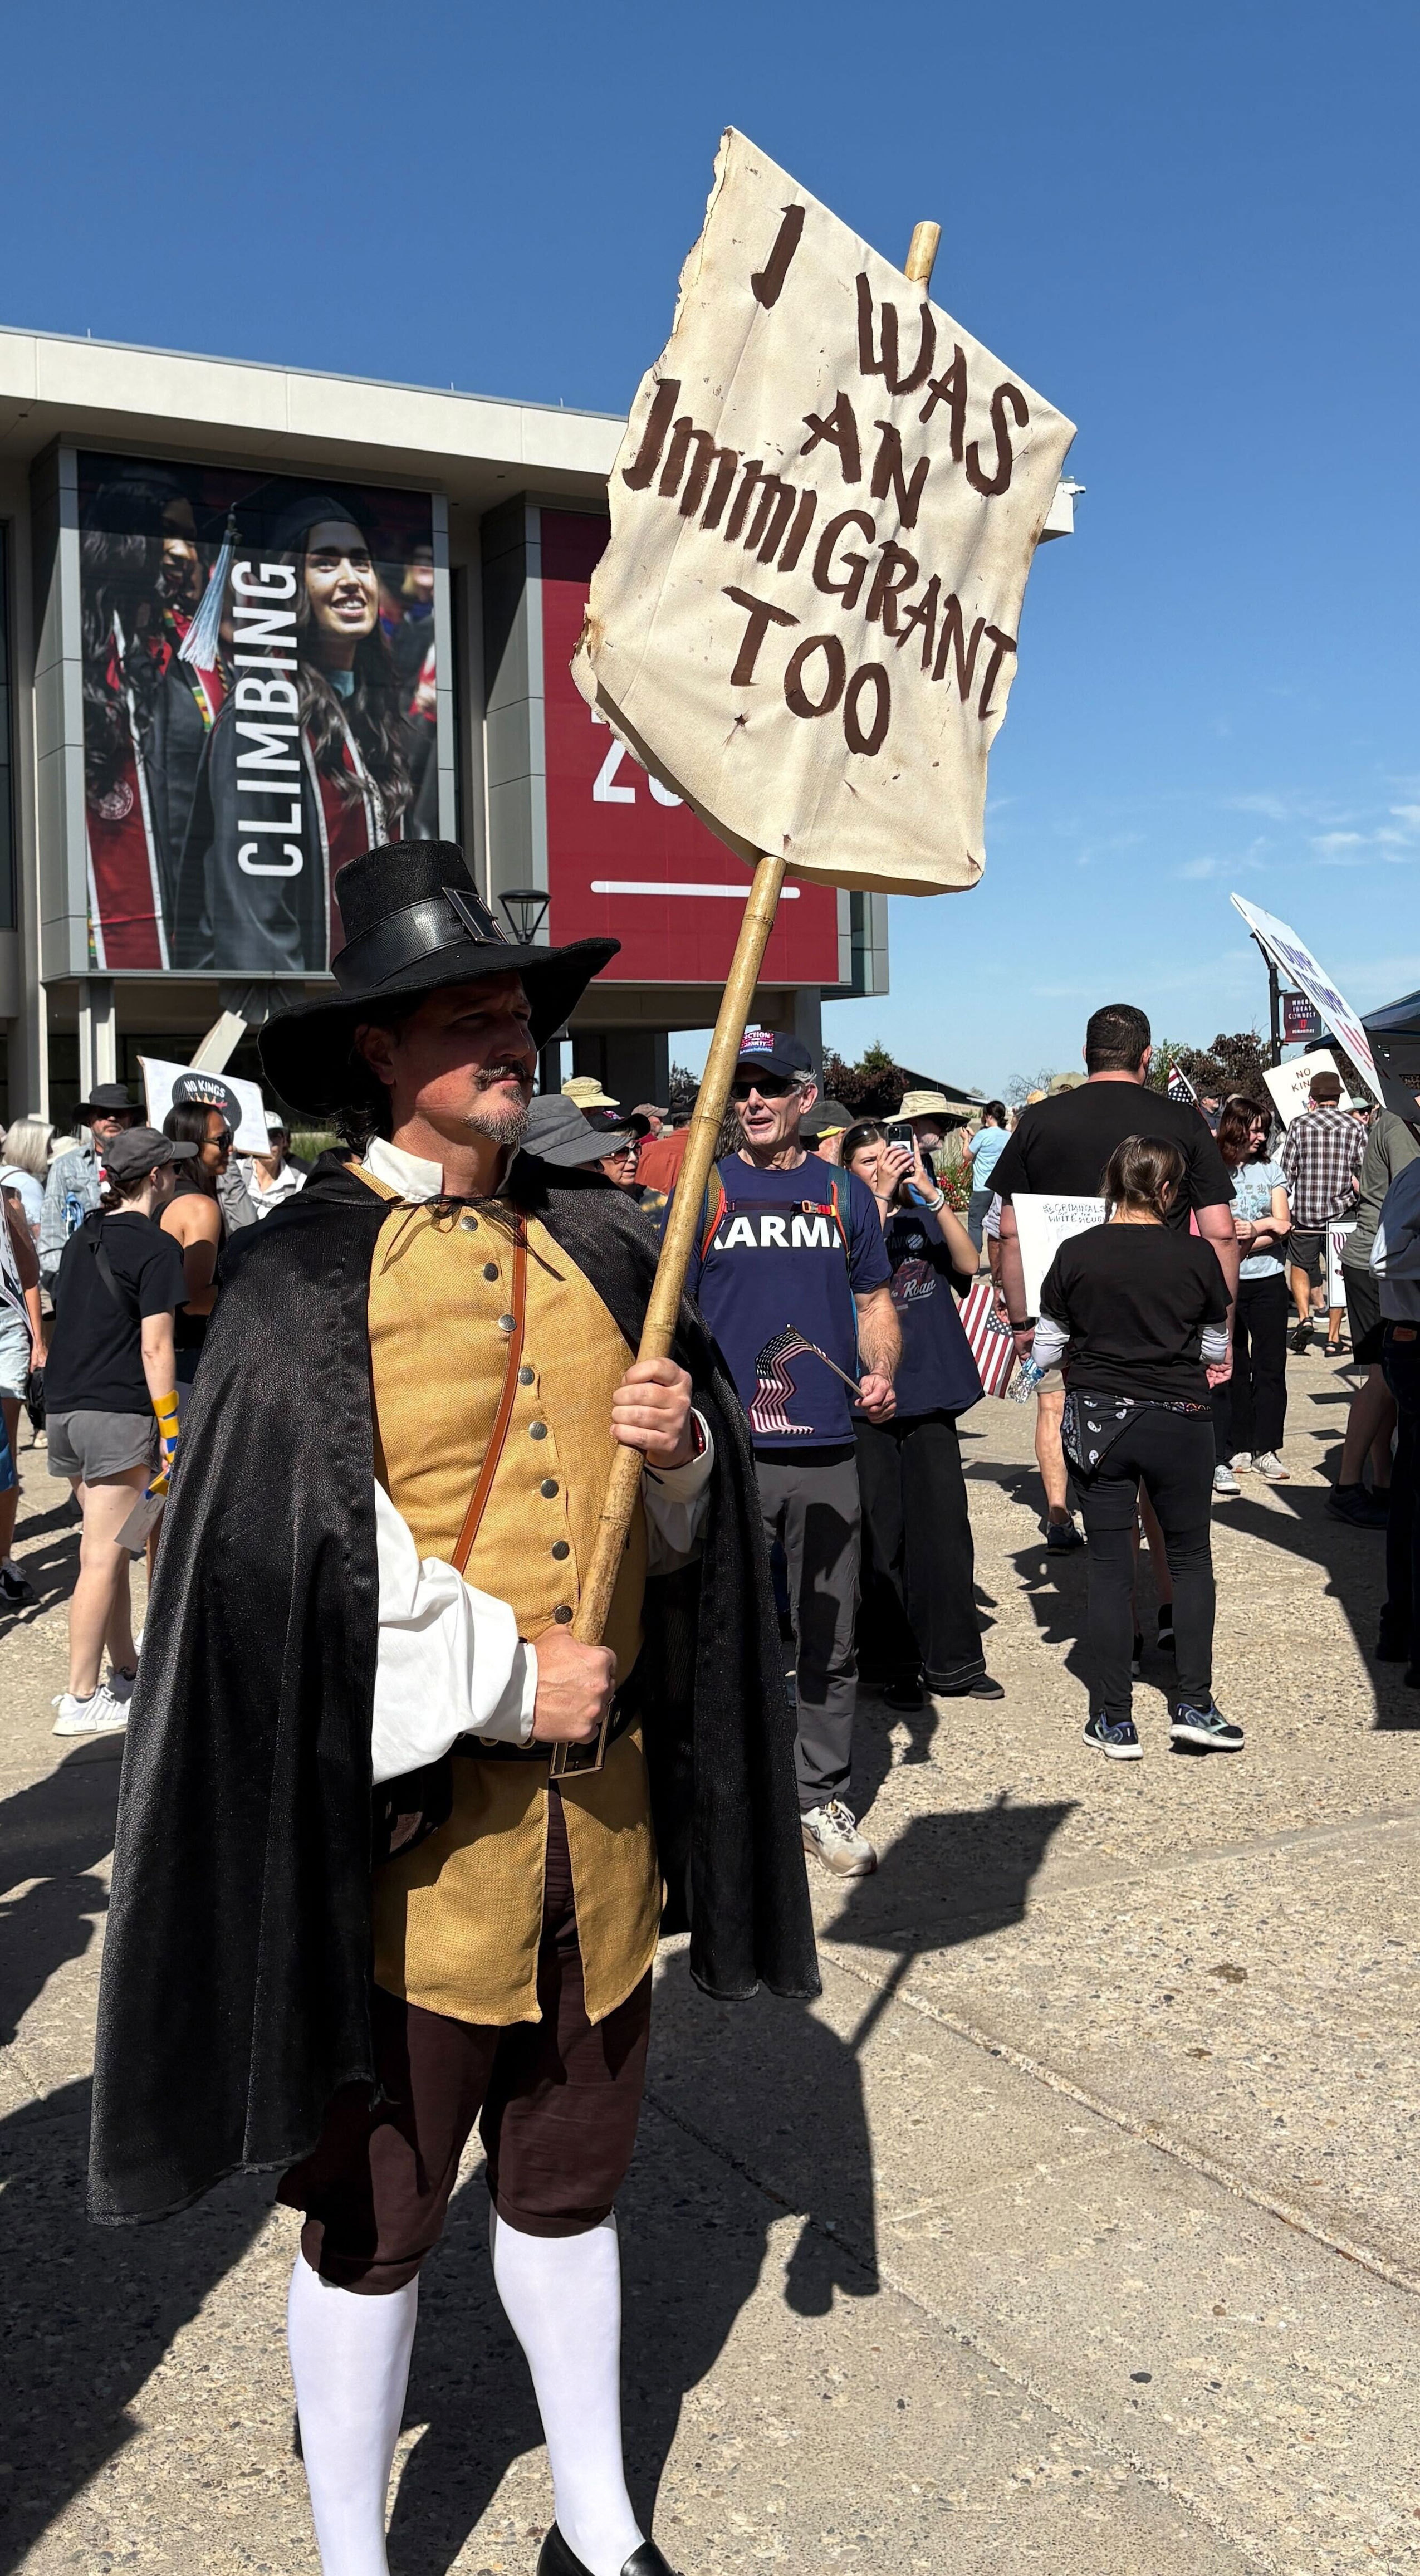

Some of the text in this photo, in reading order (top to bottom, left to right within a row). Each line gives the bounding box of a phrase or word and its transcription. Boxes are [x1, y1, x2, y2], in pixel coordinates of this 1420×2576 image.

[750, 203, 805, 310] I
[855, 271, 1029, 497] WAS
[800, 391, 931, 529] AN
[231, 560, 303, 877] CLIMBING
[722, 586, 890, 757] TOO
[184, 1080, 226, 1098] NO KINGS
[1296, 1068, 1311, 1079] NO
